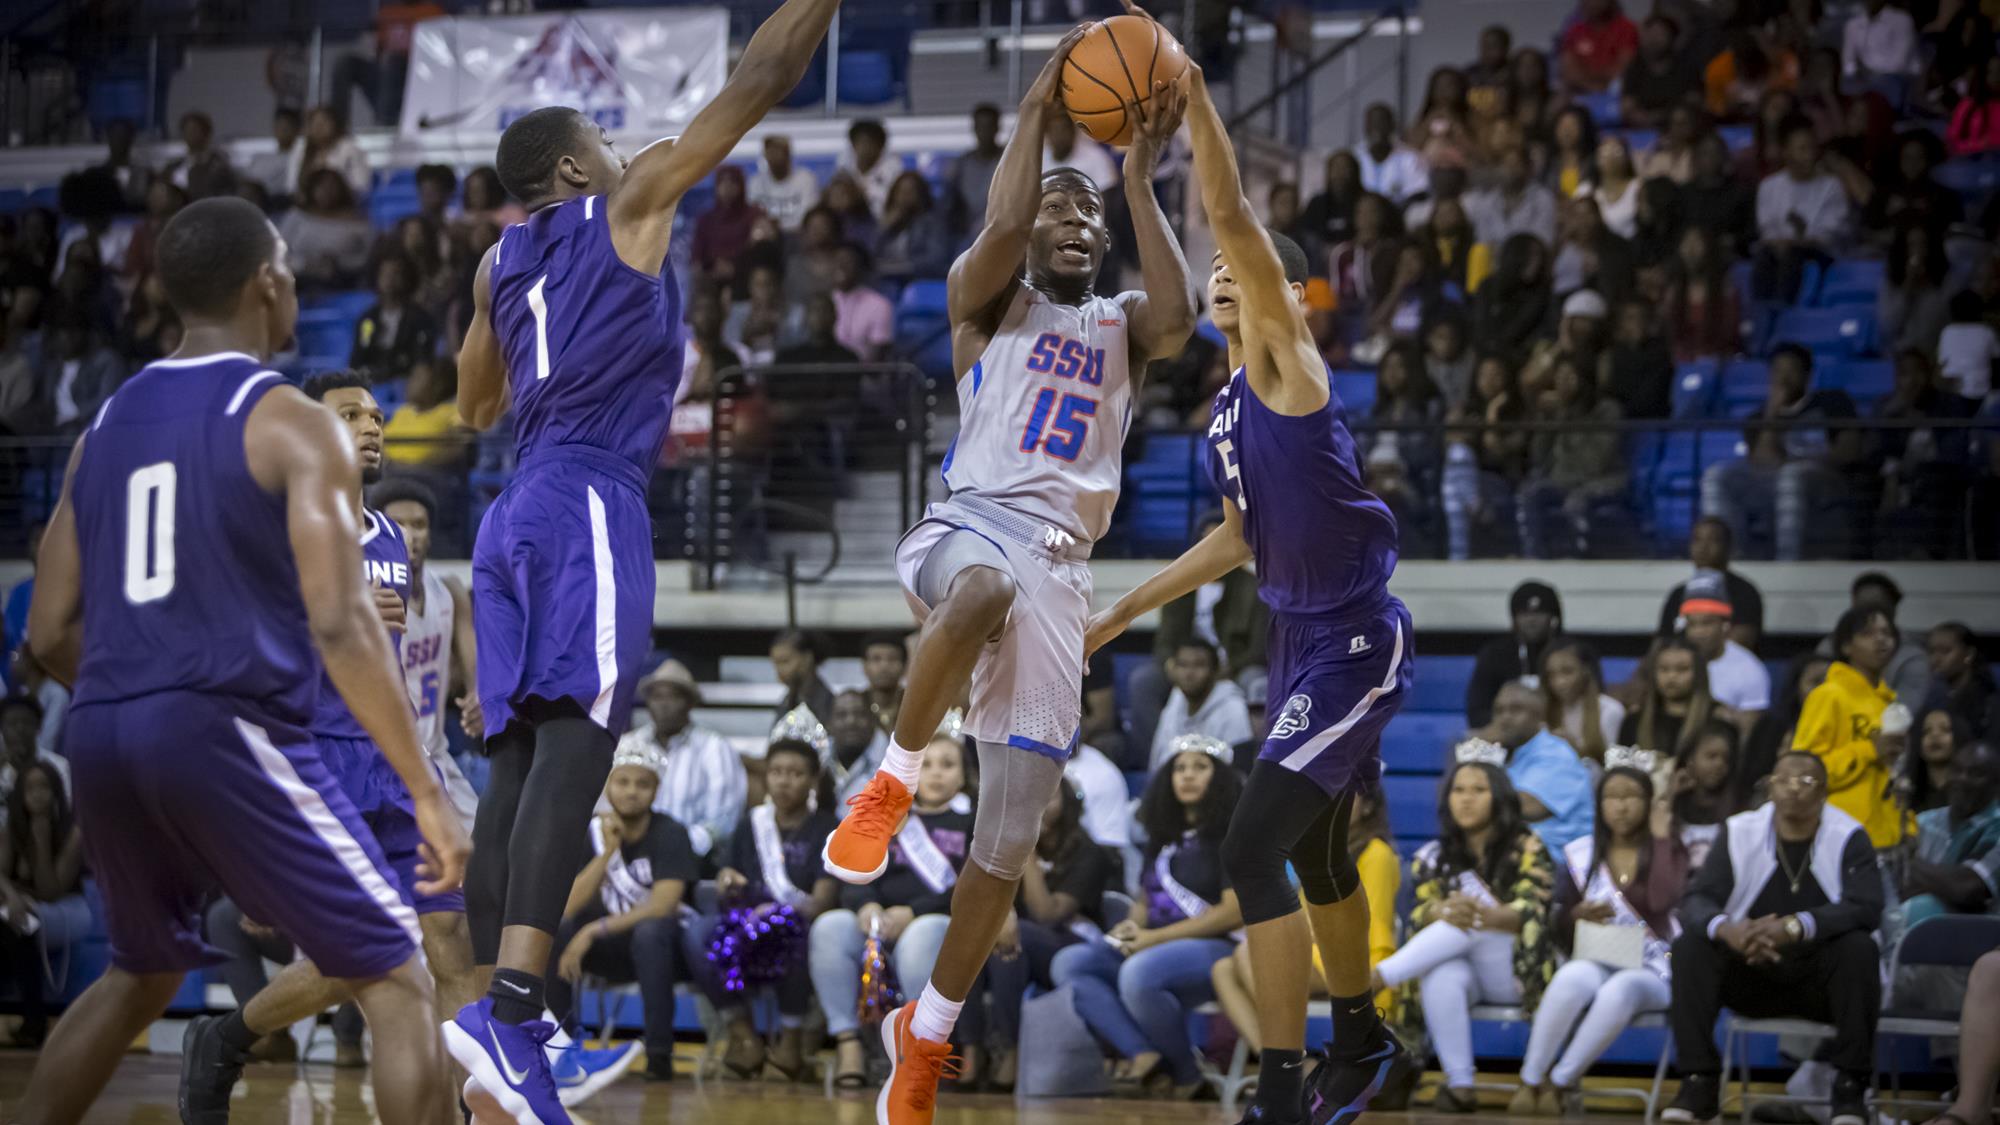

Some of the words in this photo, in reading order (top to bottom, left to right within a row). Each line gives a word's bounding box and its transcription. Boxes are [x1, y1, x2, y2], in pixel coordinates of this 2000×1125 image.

[527, 274, 550, 379] 1
[1025, 332, 1105, 386] SSU
[1019, 387, 1099, 463] 15
[1215, 438, 1248, 511] 5
[126, 461, 177, 605] 0
[406, 632, 442, 668] SSU
[419, 671, 438, 717] 5
